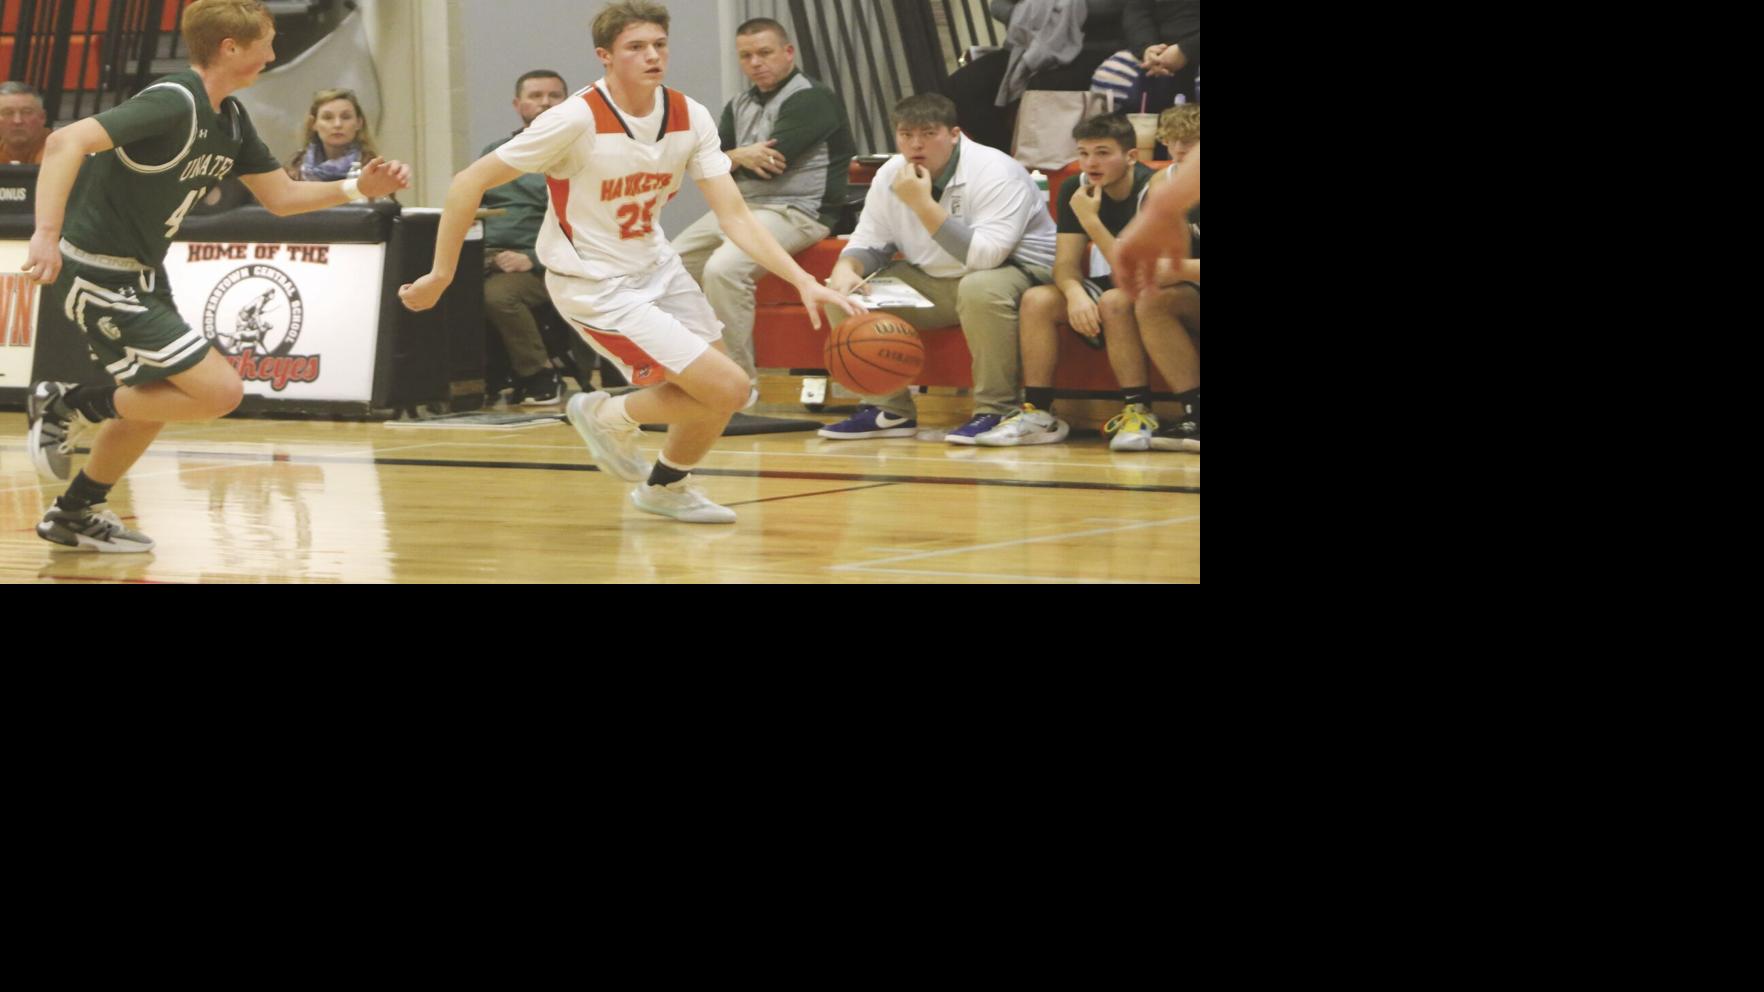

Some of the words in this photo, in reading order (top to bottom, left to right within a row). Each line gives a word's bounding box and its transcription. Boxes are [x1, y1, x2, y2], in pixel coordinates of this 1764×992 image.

[187, 244, 248, 263] HOME
[254, 244, 280, 260] OF
[286, 245, 329, 265] THE
[205, 266, 250, 340] COOPERSTOWN
[253, 265, 296, 298] CENTRAL
[284, 299, 303, 344] SCHOOL
[228, 347, 320, 391] keyes
